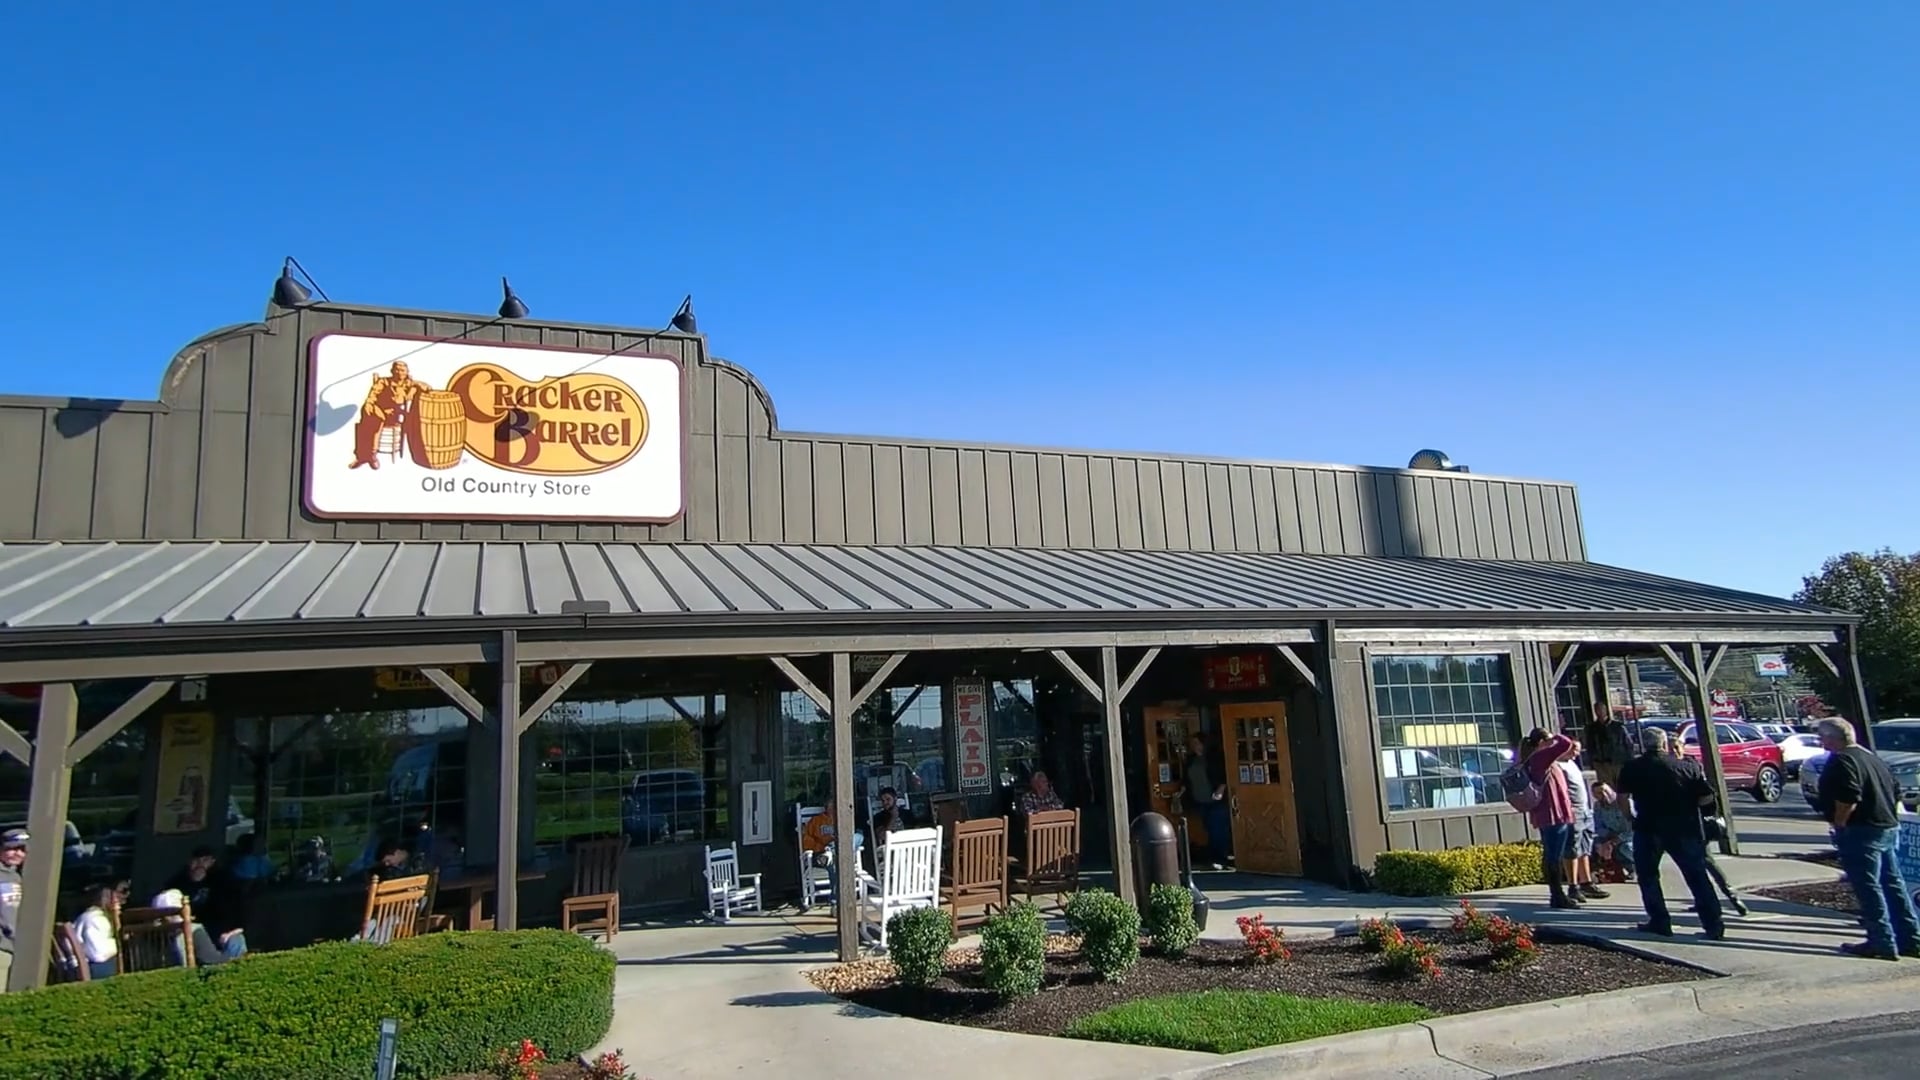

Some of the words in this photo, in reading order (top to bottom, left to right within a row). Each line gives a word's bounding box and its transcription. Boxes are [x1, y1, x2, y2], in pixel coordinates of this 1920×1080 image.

[421, 476, 456, 492] Old
[462, 477, 538, 498] Country
[543, 479, 591, 496] Store
[958, 694, 986, 778] PLAID
